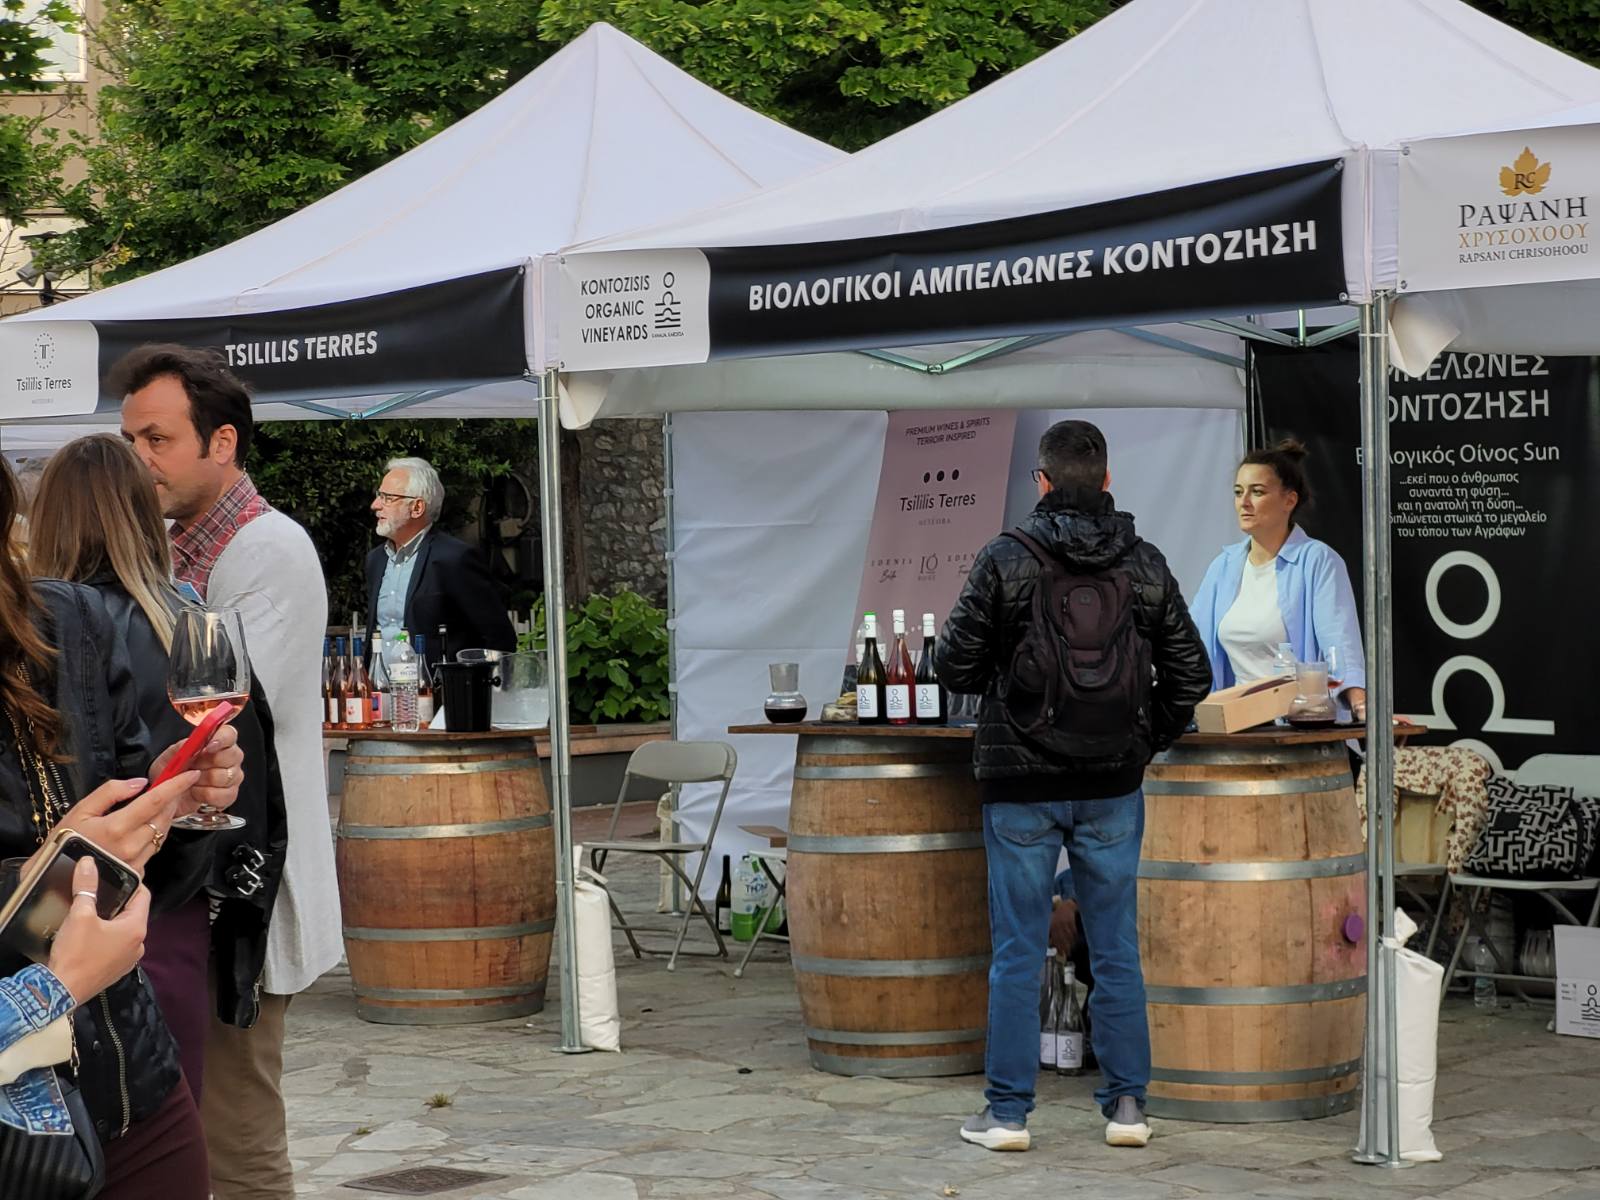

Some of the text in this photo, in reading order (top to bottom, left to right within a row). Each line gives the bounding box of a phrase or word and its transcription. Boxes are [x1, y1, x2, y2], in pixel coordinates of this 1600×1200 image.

[1458, 196, 1588, 228] ΡΑΨΑΝΗ
[1459, 222, 1588, 248] ΧΡΥΣΟΧΟΟΥ
[1459, 243, 1589, 264] RAPSANI CHRISOHOOU
[749, 219, 1317, 311] ΒΙΟΛΟΓΙΚΟΙ ΑΜΠΕΛΩΝΕΣ ΚΟΝΤΟΖΗΣΗ
[581, 275, 650, 296] KONTOZISIS
[585, 300, 644, 319] ORGANIC
[581, 324, 649, 344] VINEYARDS
[225, 330, 378, 367] TSILILIS TERRES
[1358, 353, 1549, 384] ΕΛΩΝΕΣ
[16, 377, 72, 391] Tsililis Terres
[1388, 389, 1550, 423] ΟΝΤΟΖΗΣΗ
[905, 424, 936, 437] PREMIUM
[936, 421, 960, 433] WINES
[966, 416, 991, 428] SPIRITS
[916, 430, 977, 447] TERROIR INSPIRED
[1460, 443, 1519, 464] Οίνος
[1524, 442, 1560, 461] Sun
[1429, 475, 1449, 485] που
[1452, 475, 1459, 484] ο
[1461, 471, 1519, 487] άνθρωπος
[900, 492, 976, 512] Tsililis Terres
[1409, 486, 1453, 498] συναντά
[1455, 487, 1468, 499] τη
[1397, 502, 1413, 511] και
[1415, 502, 1422, 513] η
[1424, 498, 1469, 513] ανατολή
[1471, 501, 1485, 513] τη
[1444, 511, 1482, 524] στωικά
[1484, 513, 1498, 523] το
[1500, 510, 1547, 525] μεγαλείο
[1397, 525, 1526, 540] του τόπου των Αγράφων
